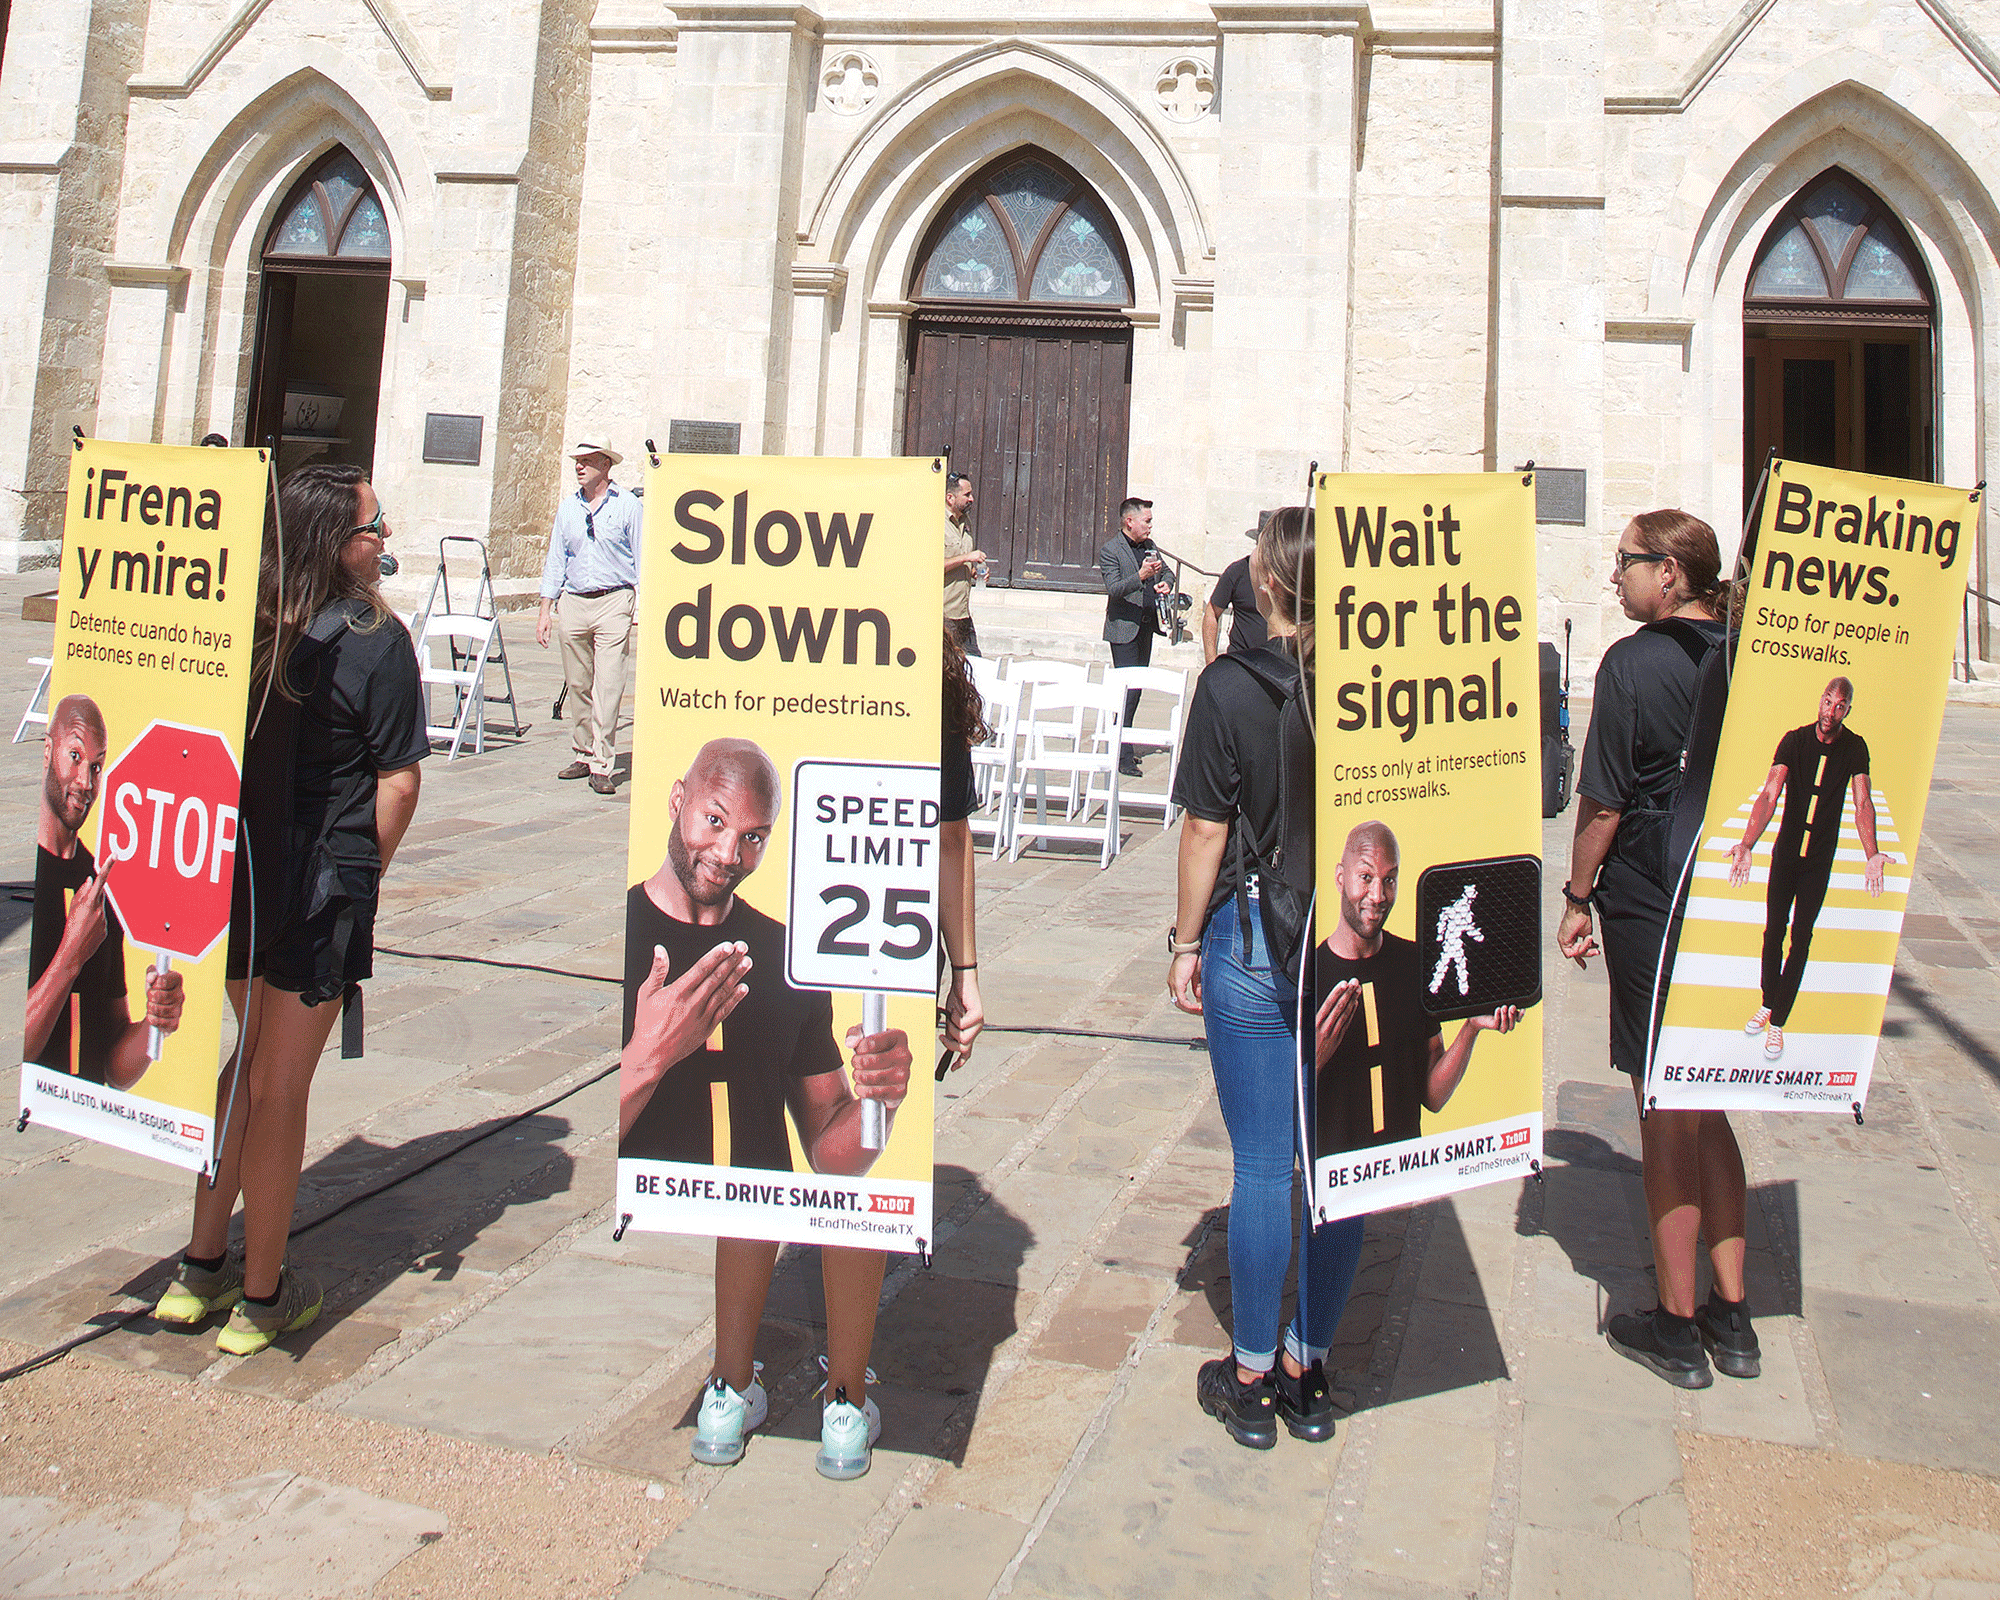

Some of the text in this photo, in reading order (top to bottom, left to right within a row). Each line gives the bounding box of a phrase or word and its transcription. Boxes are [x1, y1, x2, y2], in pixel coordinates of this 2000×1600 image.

[84, 467, 222, 531] ¡Frena
[671, 489, 874, 568] Slow
[1334, 503, 1461, 568] Wait
[1774, 481, 1961, 569] Braking
[77, 541, 229, 602] y mira!
[1762, 550, 1900, 607] news.
[70, 610, 232, 651] Detente cuando haya
[665, 583, 916, 667] down.
[1334, 581, 1522, 650] for the
[1756, 607, 1909, 644] Stop for people in
[67, 641, 229, 679] peatones en el cruce.
[1751, 638, 1851, 665] crosswalks.
[660, 687, 911, 717] Watch for pedestrians.
[1336, 657, 1518, 743] signal.
[1334, 749, 1526, 782] Cross only at intersections
[816, 795, 940, 828] SPEED
[1334, 781, 1450, 807] and crosswalks.
[109, 782, 239, 884] STOP
[826, 834, 930, 867] LIMIT
[817, 884, 932, 960] 25
[1664, 1065, 1684, 1081] BE
[1686, 1067, 1725, 1083] SAFE.
[1729, 1069, 1773, 1085] DRIVE
[1775, 1070, 1823, 1086] SMART.
[1784, 1090, 1852, 1102] #EndTheStreakTX
[36, 1079, 70, 1101] MANEJA
[72, 1090, 98, 1110] LISTO.
[101, 1099, 137, 1122] MANEJA
[139, 1111, 177, 1135] SEGURO.
[1329, 1130, 1528, 1188] BE SAFE. WALK SMART. TxDOT
[1458, 1151, 1531, 1175] #EndTheStreakTX
[636, 1174, 910, 1212] BE SAFE. DRIVE SMART. TxDOT
[809, 1217, 913, 1236] #EndTheStreakTX
